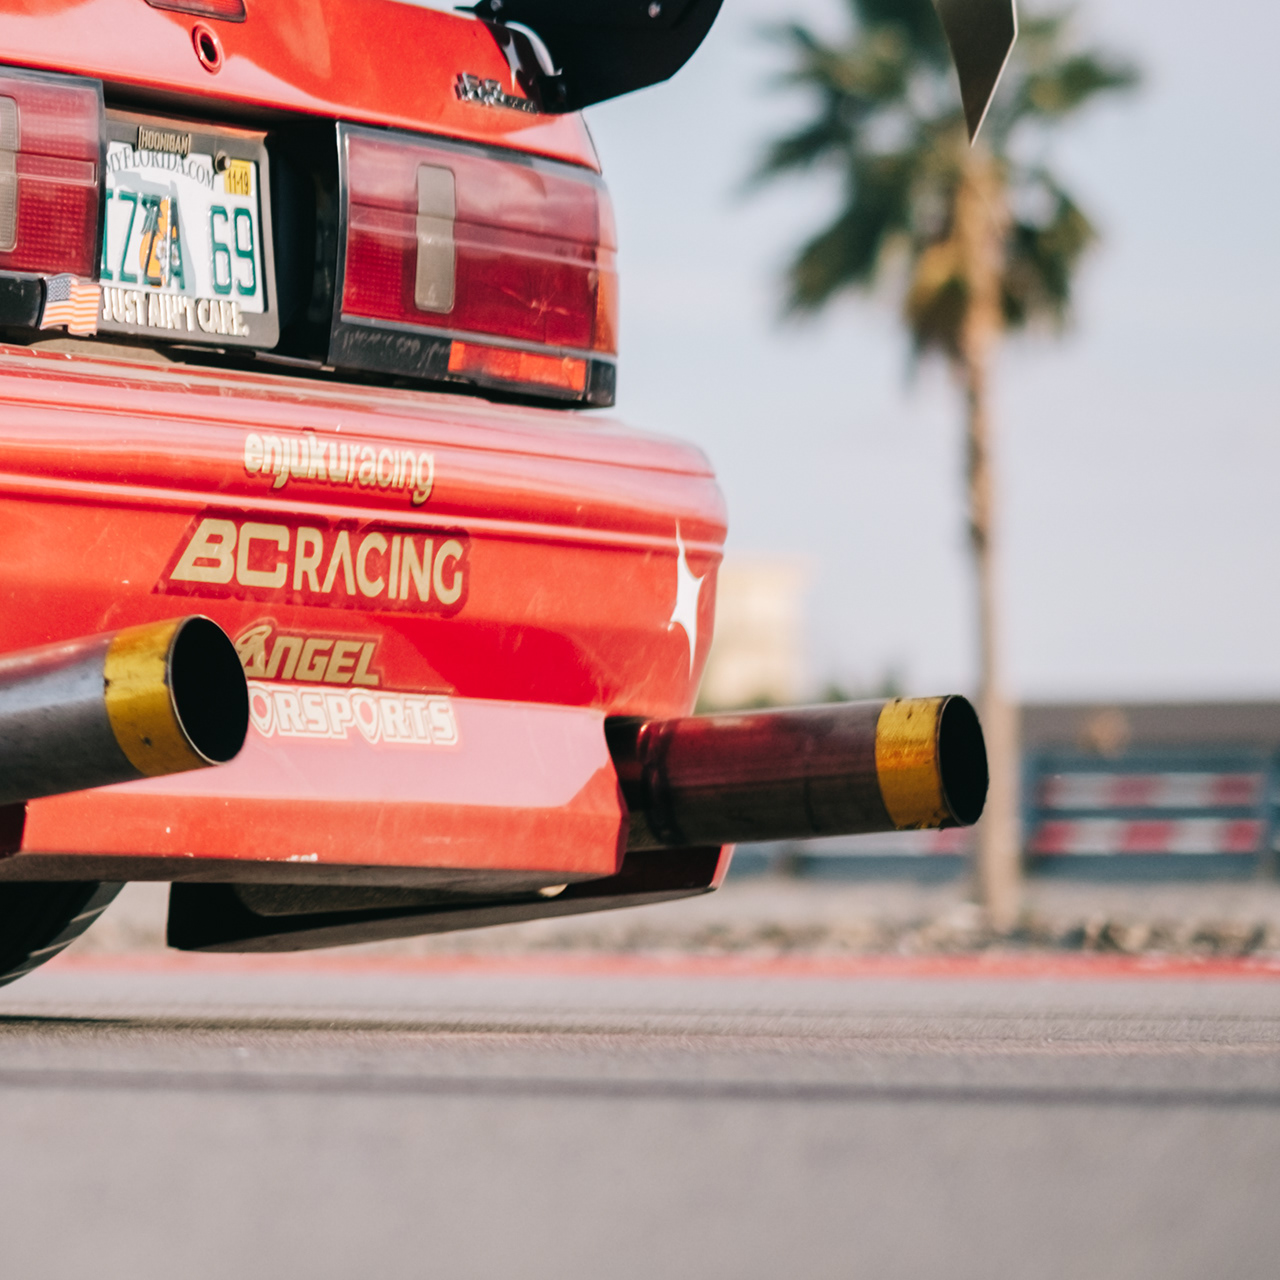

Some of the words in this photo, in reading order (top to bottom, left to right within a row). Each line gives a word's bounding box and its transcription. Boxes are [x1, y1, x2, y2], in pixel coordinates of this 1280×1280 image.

[210, 205, 257, 297] 69
[102, 286, 146, 326] JUST
[147, 292, 196, 333] AIN'T
[244, 431, 435, 505] enjukuracing
[292, 526, 464, 605] RACING
[236, 624, 381, 686] ANGEL
[248, 684, 459, 745] ORSPORTS
